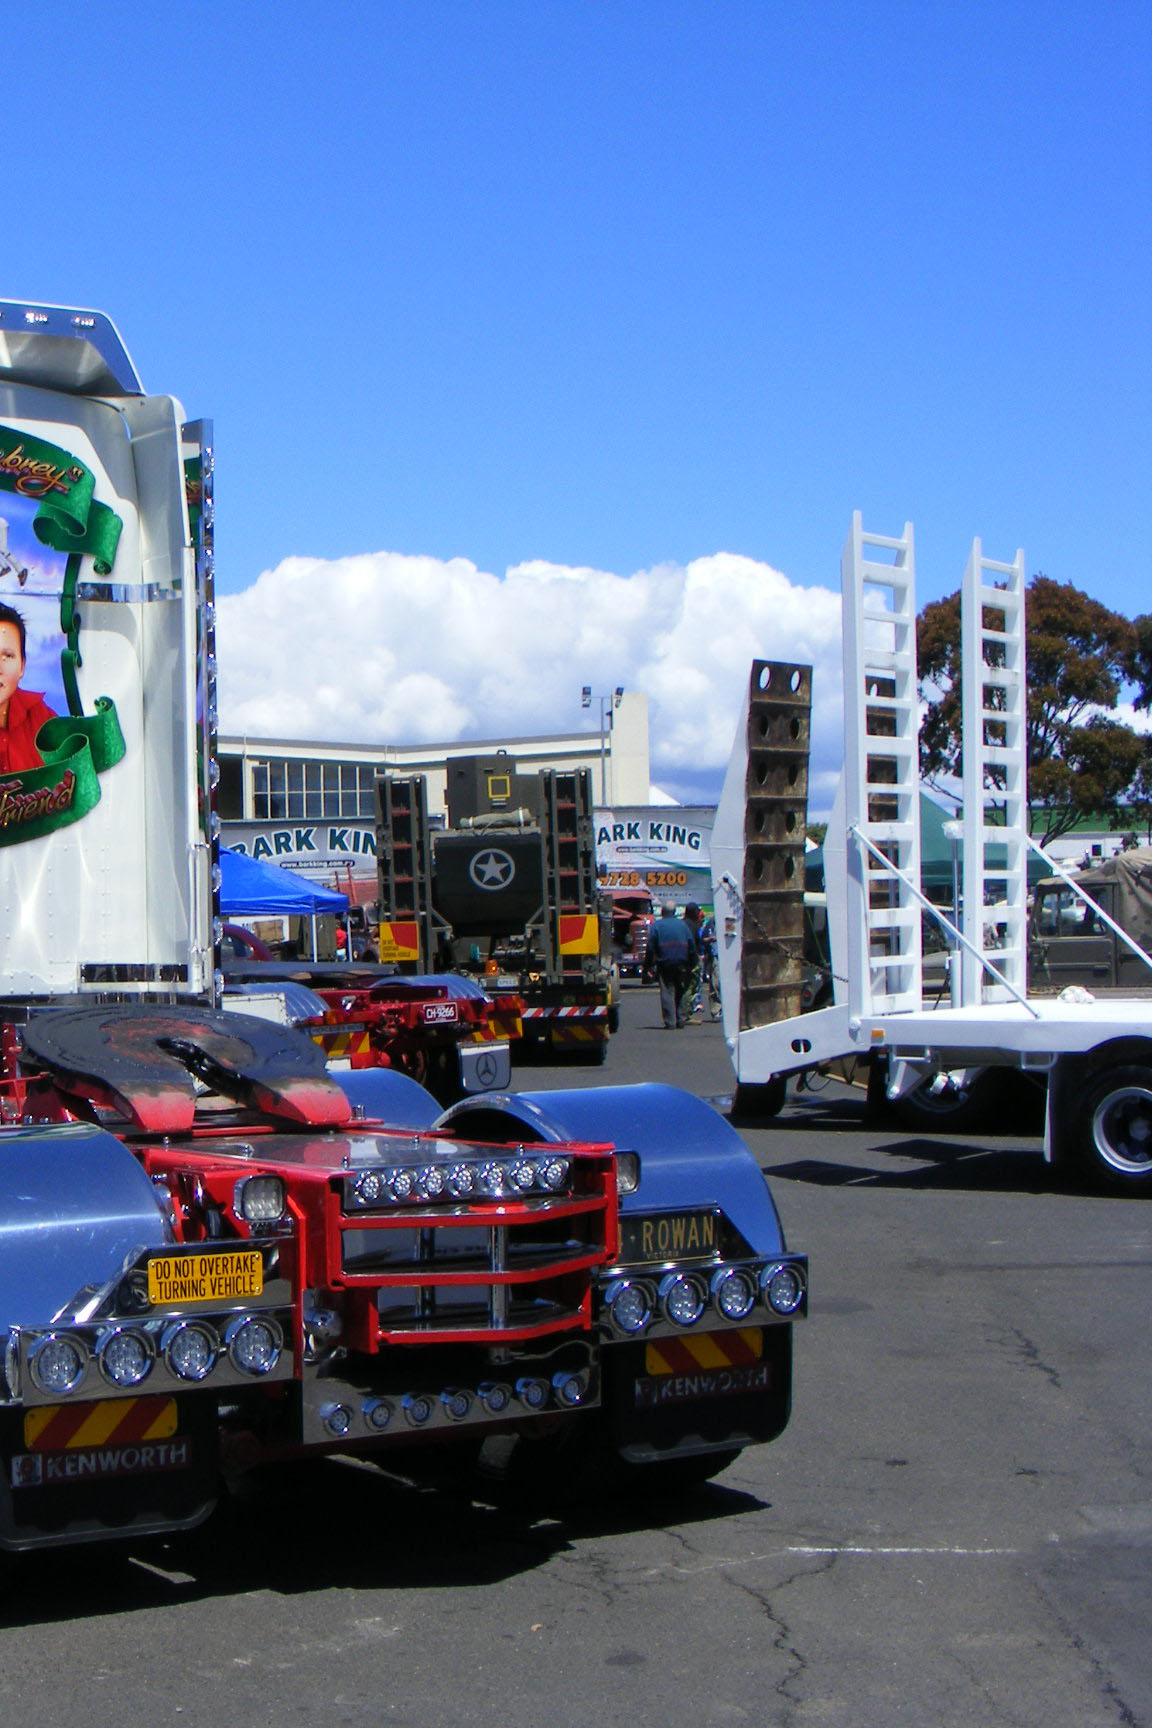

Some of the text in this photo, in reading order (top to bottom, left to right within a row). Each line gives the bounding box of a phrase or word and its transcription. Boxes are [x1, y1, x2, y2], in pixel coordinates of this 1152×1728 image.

[649, 822, 701, 851] KING
[645, 871, 688, 887] 5200
[642, 1215, 715, 1252] ROWAN
[156, 1254, 257, 1280] DO NOT OVERTAKE
[158, 1275, 255, 1300] TURNING VEHICLE
[46, 1443, 187, 1479] KENWORTH
